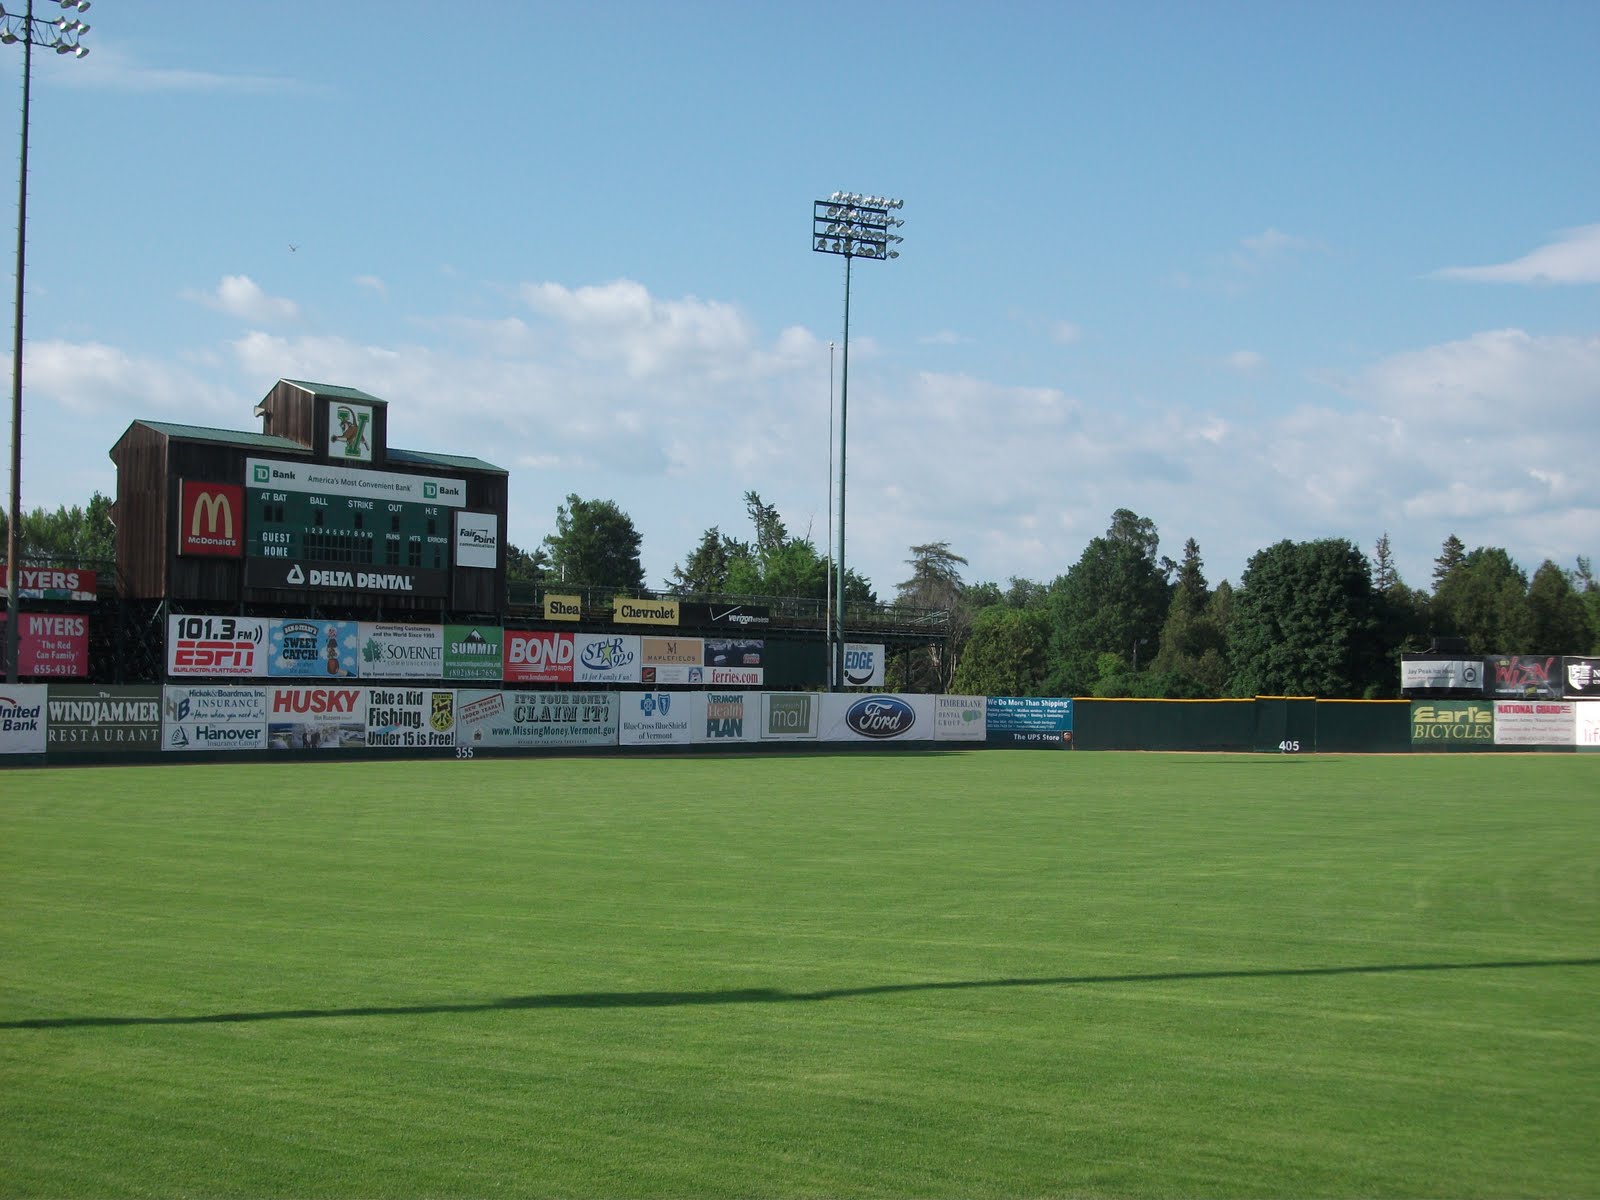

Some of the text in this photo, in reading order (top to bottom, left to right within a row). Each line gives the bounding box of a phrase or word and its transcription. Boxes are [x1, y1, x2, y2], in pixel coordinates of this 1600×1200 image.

[272, 470, 295, 479] Bank
[308, 475, 339, 484] America's
[358, 480, 394, 490] Convenient
[395, 484, 411, 492] Bank
[439, 487, 459, 495] Bank
[273, 494, 287, 502] BAT
[310, 497, 328, 505] BALL
[348, 500, 373, 510] STRIKE
[388, 504, 403, 512] OUT
[262, 532, 290, 543] GUEST
[460, 528, 476, 537] Fair
[188, 537, 236, 546] McDonald's
[473, 535, 495, 544] Point
[264, 546, 288, 556] HOME
[309, 570, 413, 590] DELTA DENTAL
[549, 601, 580, 614] Shea
[621, 605, 675, 622] Chevrolet
[30, 617, 84, 636] MYERS
[178, 618, 252, 640] 101.3 FM
[57, 641, 71, 649] Red
[284, 637, 318, 648] SWEET
[452, 642, 498, 655] SUMMIT
[509, 633, 574, 664] BOND
[37, 650, 49, 659] Can
[175, 641, 255, 666] ESPN
[283, 649, 319, 660] CATCH!
[387, 645, 443, 660] SOVERNET
[845, 651, 874, 670] EDGE
[34, 665, 77, 674] 655-4312
[591, 673, 599, 682] for
[600, 673, 618, 681] Family
[712, 669, 758, 684] ferries.com
[198, 699, 259, 708] INSURANCE
[273, 690, 361, 713] HUSKY
[369, 690, 424, 705] Take a Kid
[514, 694, 536, 704] IT'S
[539, 694, 569, 704] YOUR
[707, 693, 743, 704] VERMONT
[939, 698, 983, 708] TIMBERLANE
[987, 698, 997, 706] We
[48, 701, 160, 725] WINDJAMMER
[210, 710, 225, 718] when
[225, 712, 236, 721] you
[238, 710, 251, 718] need
[461, 711, 480, 719] ADDED
[481, 703, 502, 713] YEARLY
[513, 705, 578, 723] CLAIM
[708, 704, 742, 718] Health
[772, 699, 808, 727] mall
[1413, 706, 1493, 723] Earl's
[1498, 704, 1561, 714] NATIONAL GUARD
[369, 707, 424, 729] Fishing.
[859, 702, 902, 730] Ford
[2, 718, 38, 731] Bank
[706, 719, 742, 738] PLAN
[48, 728, 160, 742] RESTAURANT
[196, 726, 262, 740] Hanover
[368, 731, 455, 745] Under 15 is Free!
[491, 725, 616, 738] www.MissingMoney.Vermont.gov
[1014, 733, 1026, 741] The
[1414, 724, 1492, 739] BICYCLES
[1278, 740, 1300, 751] 405
[455, 747, 474, 758] 355
